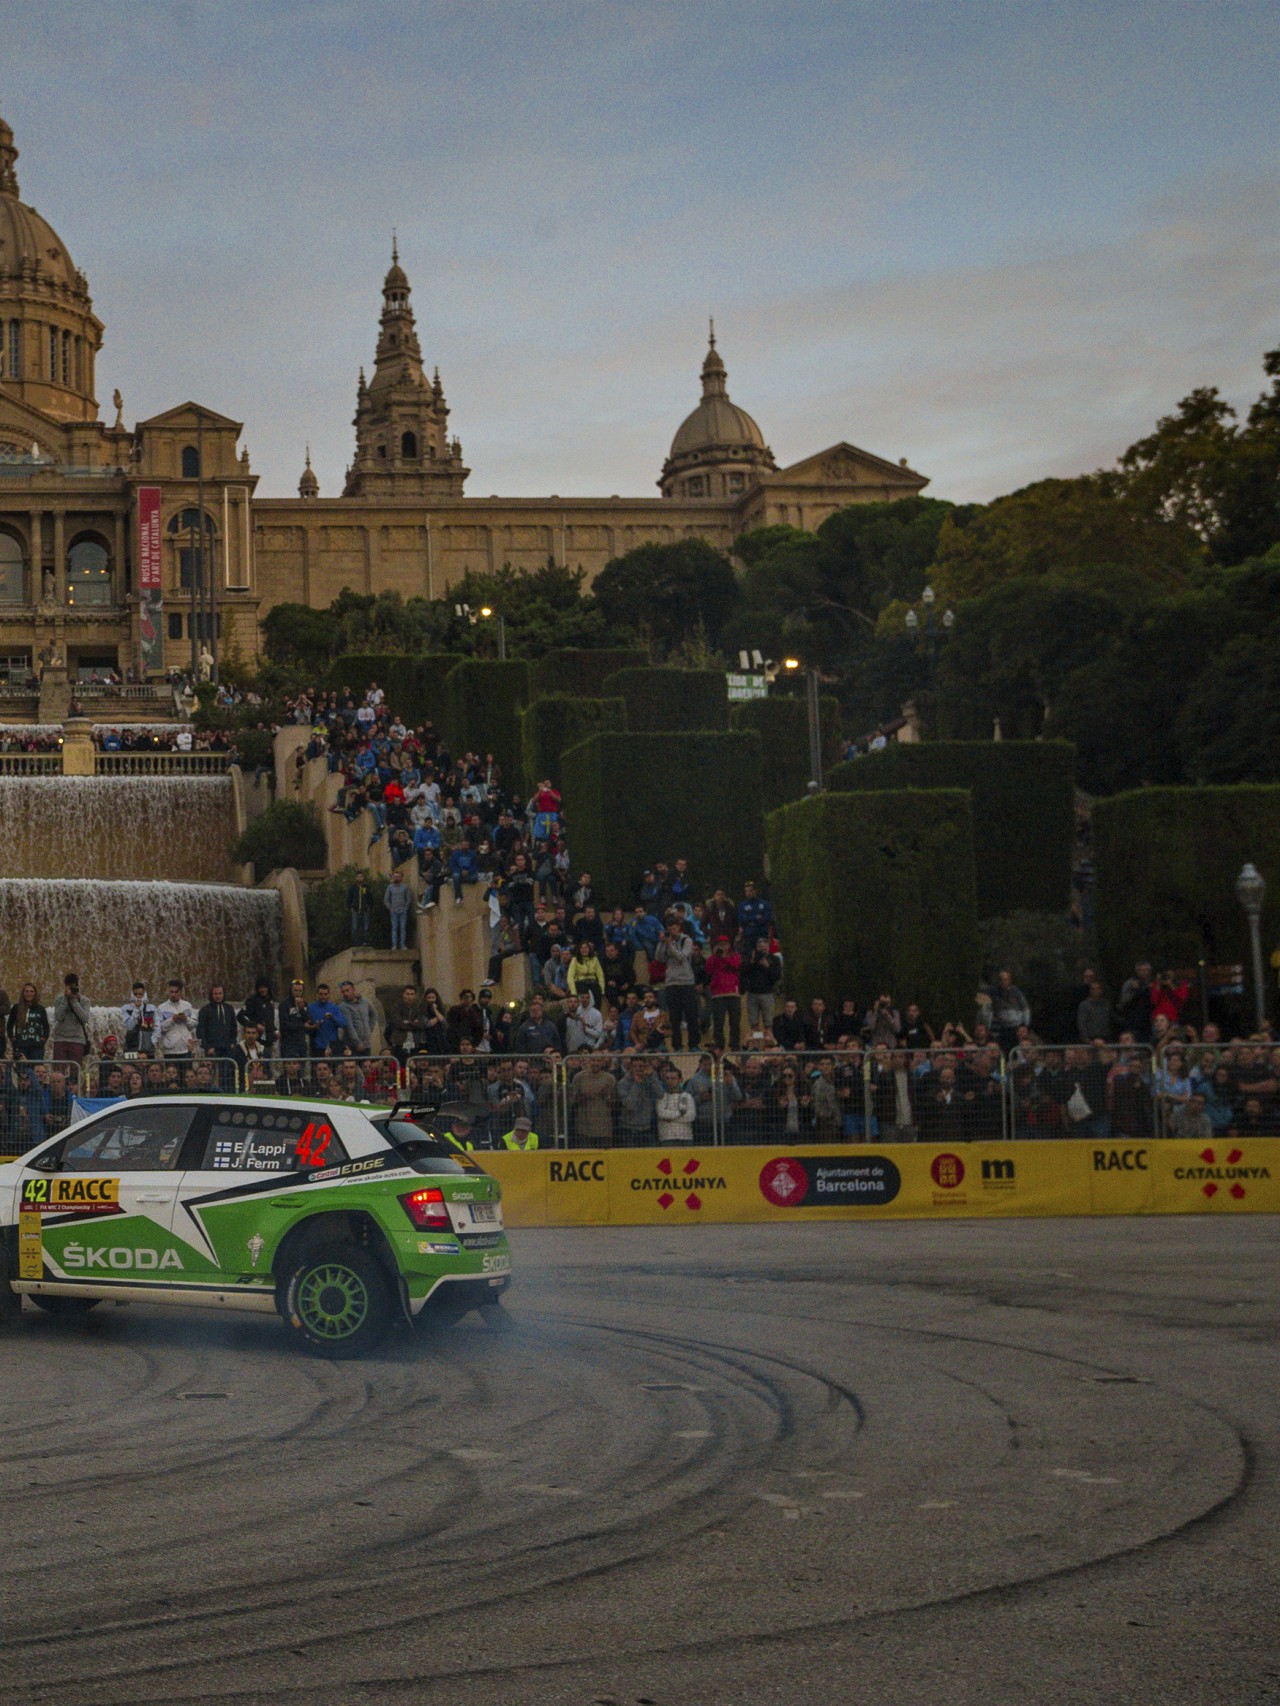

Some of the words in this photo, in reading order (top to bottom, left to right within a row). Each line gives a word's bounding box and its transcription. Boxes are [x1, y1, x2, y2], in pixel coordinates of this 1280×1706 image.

[141, 522, 150, 556] NACIONAL
[150, 510, 160, 549] CATALUNYA
[151, 551, 160, 560] DE
[141, 558, 151, 583] MUSEU
[234, 1143, 245, 1153] E.
[251, 1143, 286, 1156] Lappi
[295, 1122, 332, 1167] 42
[231, 1158, 242, 1168] J.
[246, 1157, 280, 1169] Ferm
[316, 1168, 340, 1179] Castrol
[341, 1157, 386, 1175] EDGE
[549, 1160, 605, 1182] RACC
[1093, 1149, 1148, 1171] RACC
[347, 1169, 412, 1184] www.skoda-auto.com
[630, 1177, 727, 1191] CATALUNYA
[816, 1167, 871, 1179] Ajuntament
[871, 1167, 884, 1177] de
[1173, 1167, 1271, 1180] CATALUNYA
[24, 1179, 48, 1202] 42
[58, 1179, 112, 1201] RACC
[816, 1179, 885, 1193] Barcelona
[63, 1242, 184, 1270] ŠKODA
